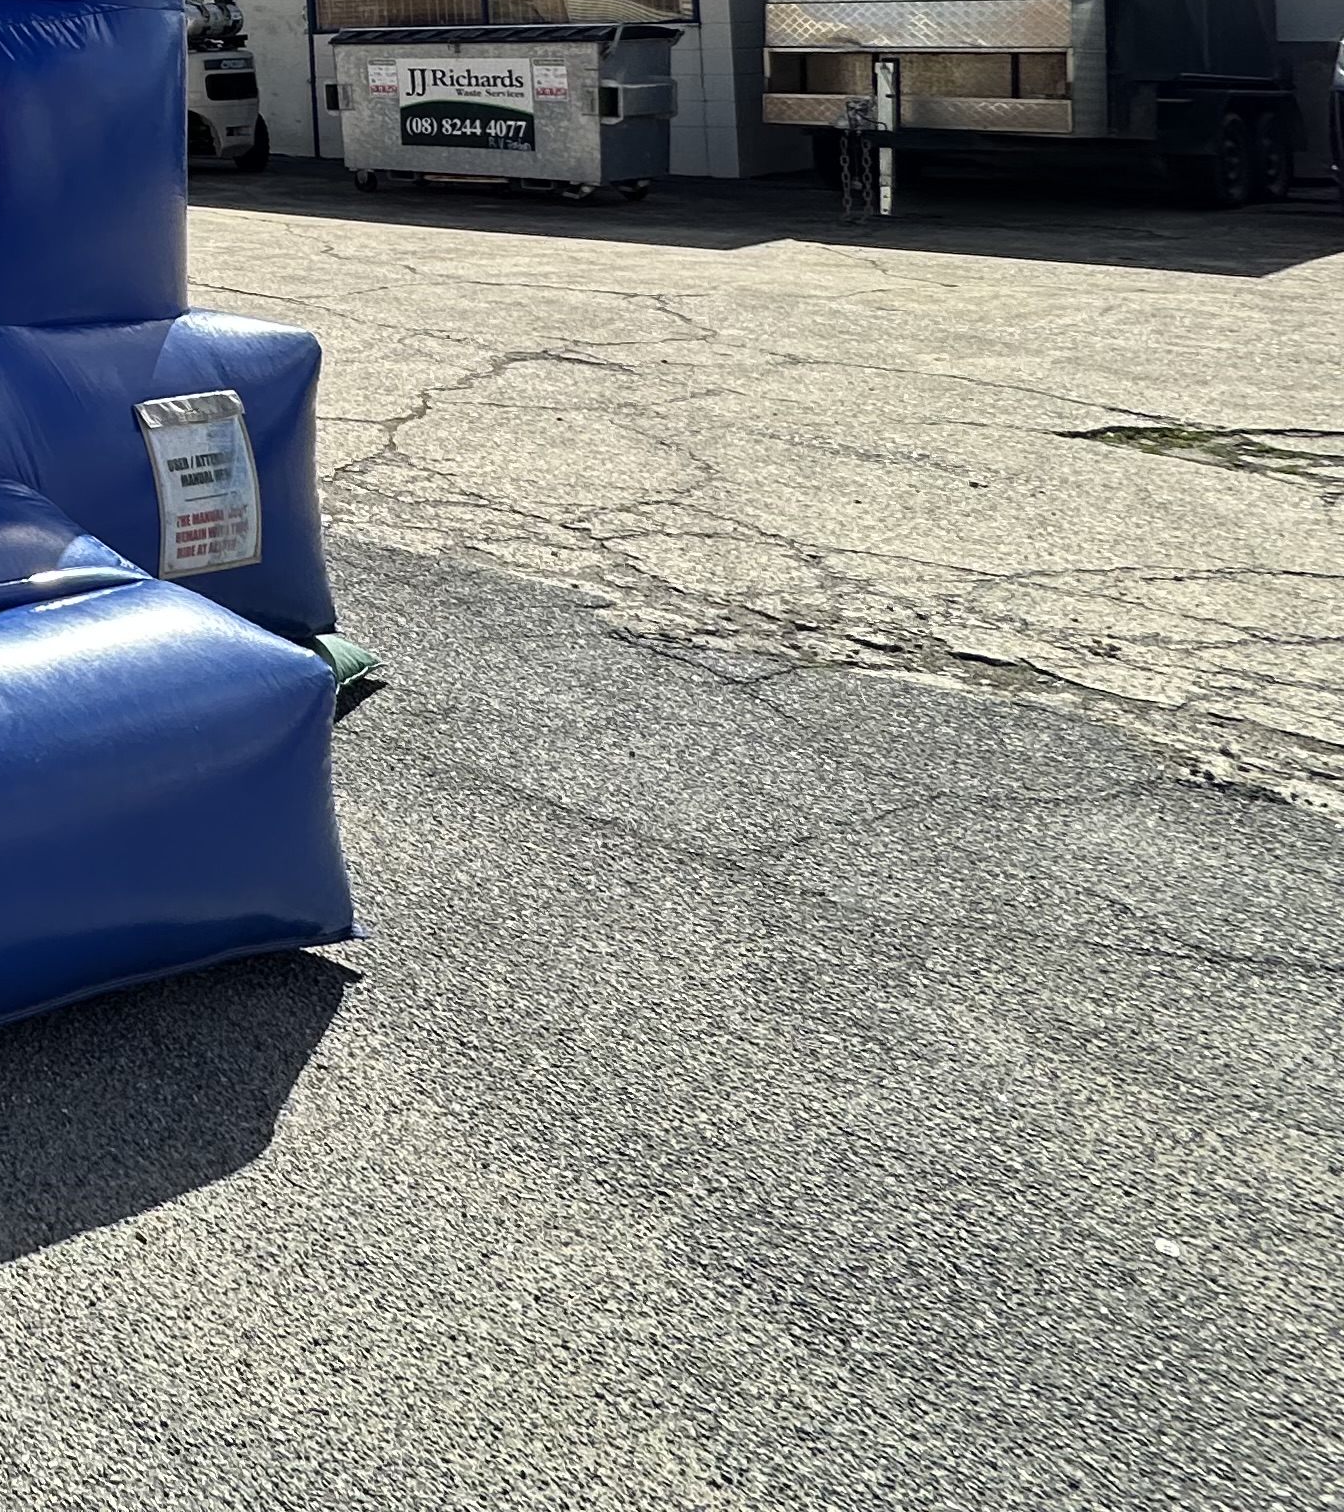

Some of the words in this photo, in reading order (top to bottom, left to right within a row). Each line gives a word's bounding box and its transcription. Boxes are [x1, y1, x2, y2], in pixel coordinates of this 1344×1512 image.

[406, 68, 428, 96] JJ
[431, 69, 524, 88] Richards
[486, 90, 524, 98] Services
[406, 117, 438, 135] (08)
[442, 119, 481, 135] 8244
[486, 120, 526, 137] 4077
